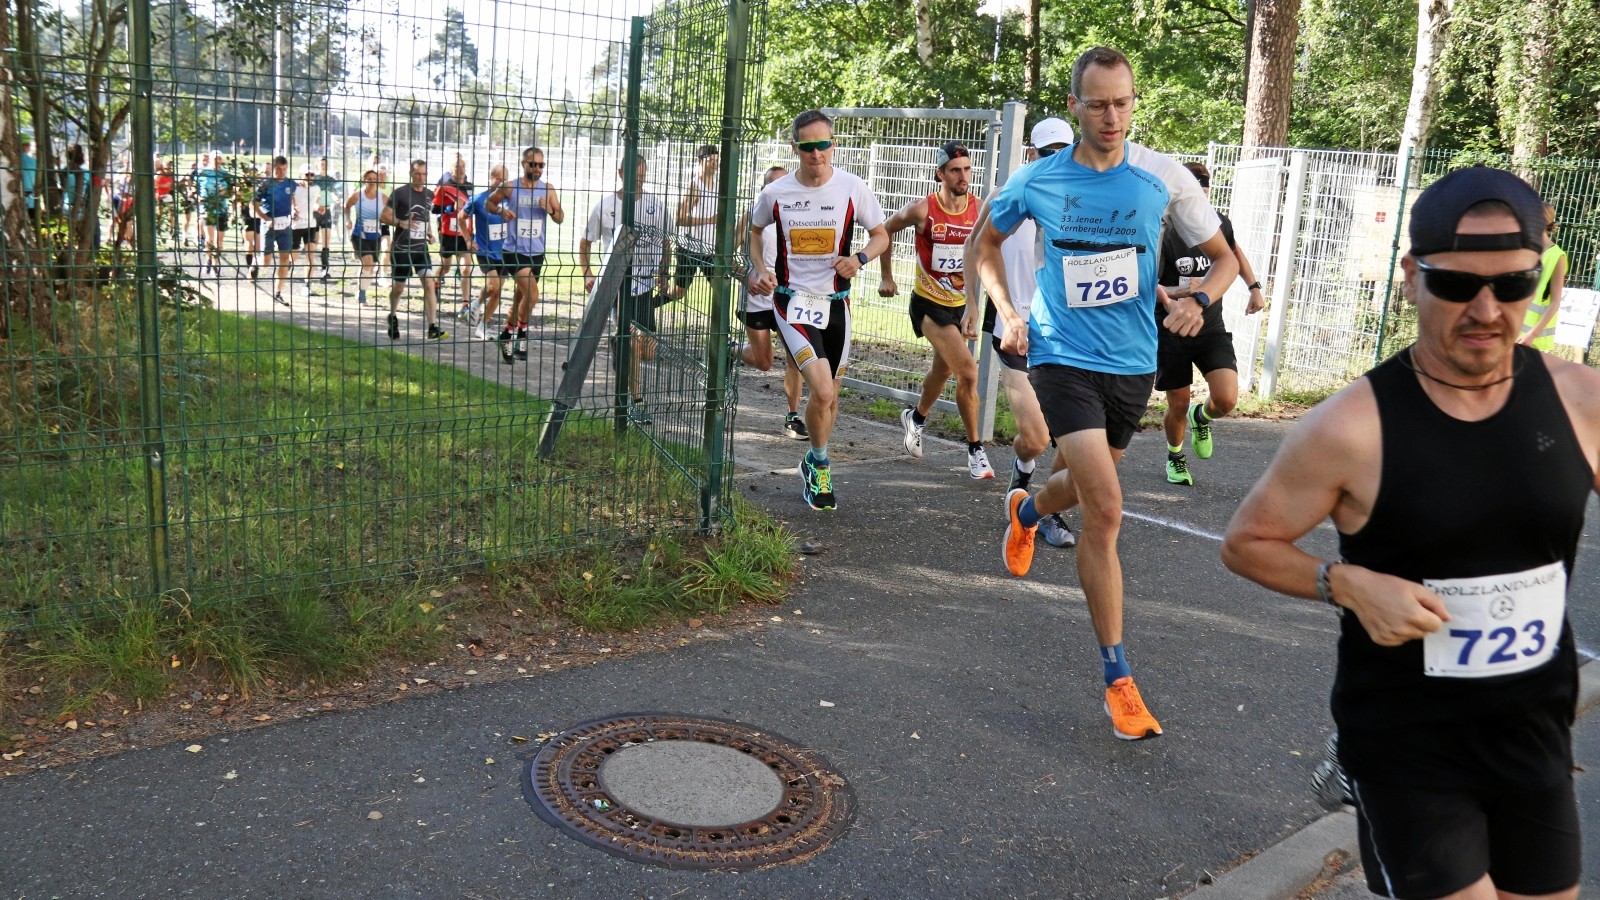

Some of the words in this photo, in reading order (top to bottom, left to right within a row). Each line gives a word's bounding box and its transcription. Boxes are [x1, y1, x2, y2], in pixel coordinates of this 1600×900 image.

[788, 218, 837, 227] Ostseeurlaub
[1061, 215, 1074, 223] 33.
[1075, 215, 1104, 225] Jenaer
[520, 228, 538, 237] 733
[1059, 224, 1114, 237] Kernberglauf
[1115, 227, 1137, 236] 2009
[938, 258, 964, 270] 732
[1067, 251, 1132, 267] HOLZLANDLAUF
[1076, 276, 1129, 302] 726
[794, 306, 824, 325] 712
[1434, 570, 1561, 597] HOLZLANDLAUF
[1449, 619, 1546, 666] 723
